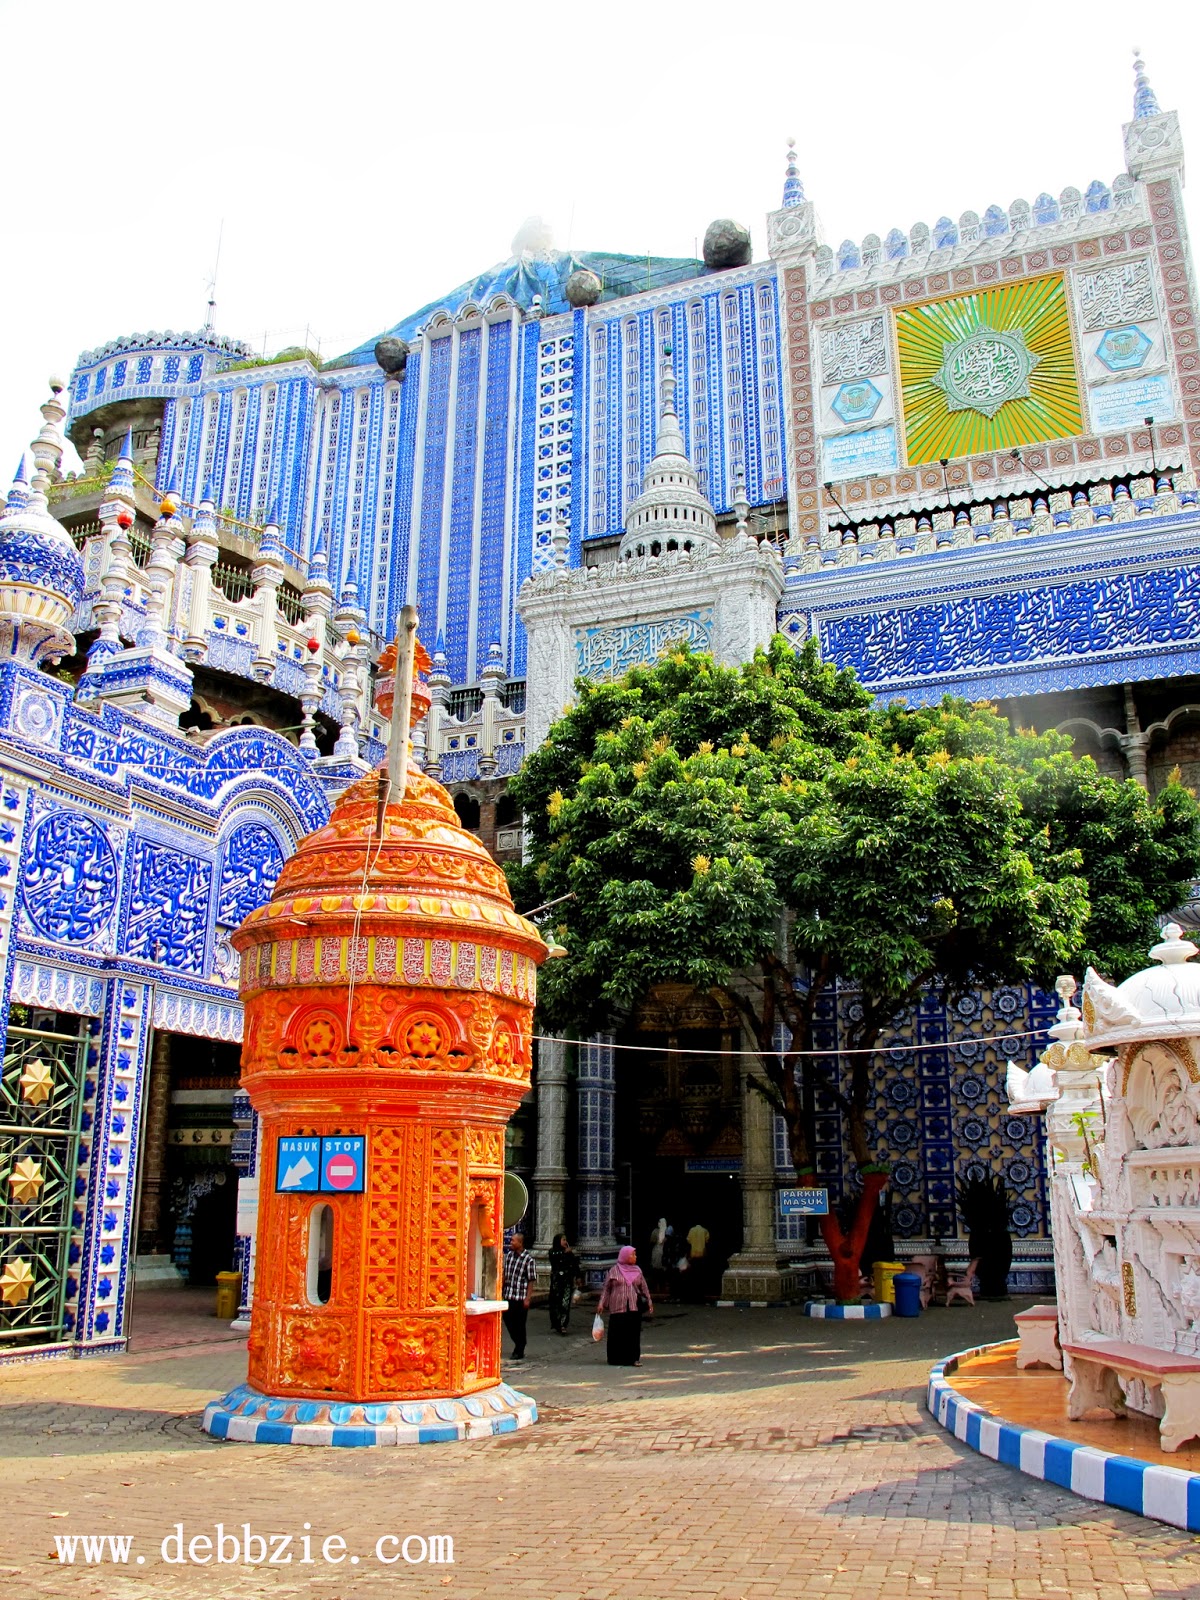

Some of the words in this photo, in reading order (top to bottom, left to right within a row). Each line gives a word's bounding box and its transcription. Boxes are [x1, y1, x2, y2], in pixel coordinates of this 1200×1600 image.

[281, 1142, 318, 1152] MASUK
[325, 1141, 361, 1152] STOP
[783, 1190, 823, 1198] PARKIR
[783, 1198, 823, 1206] MASUK
